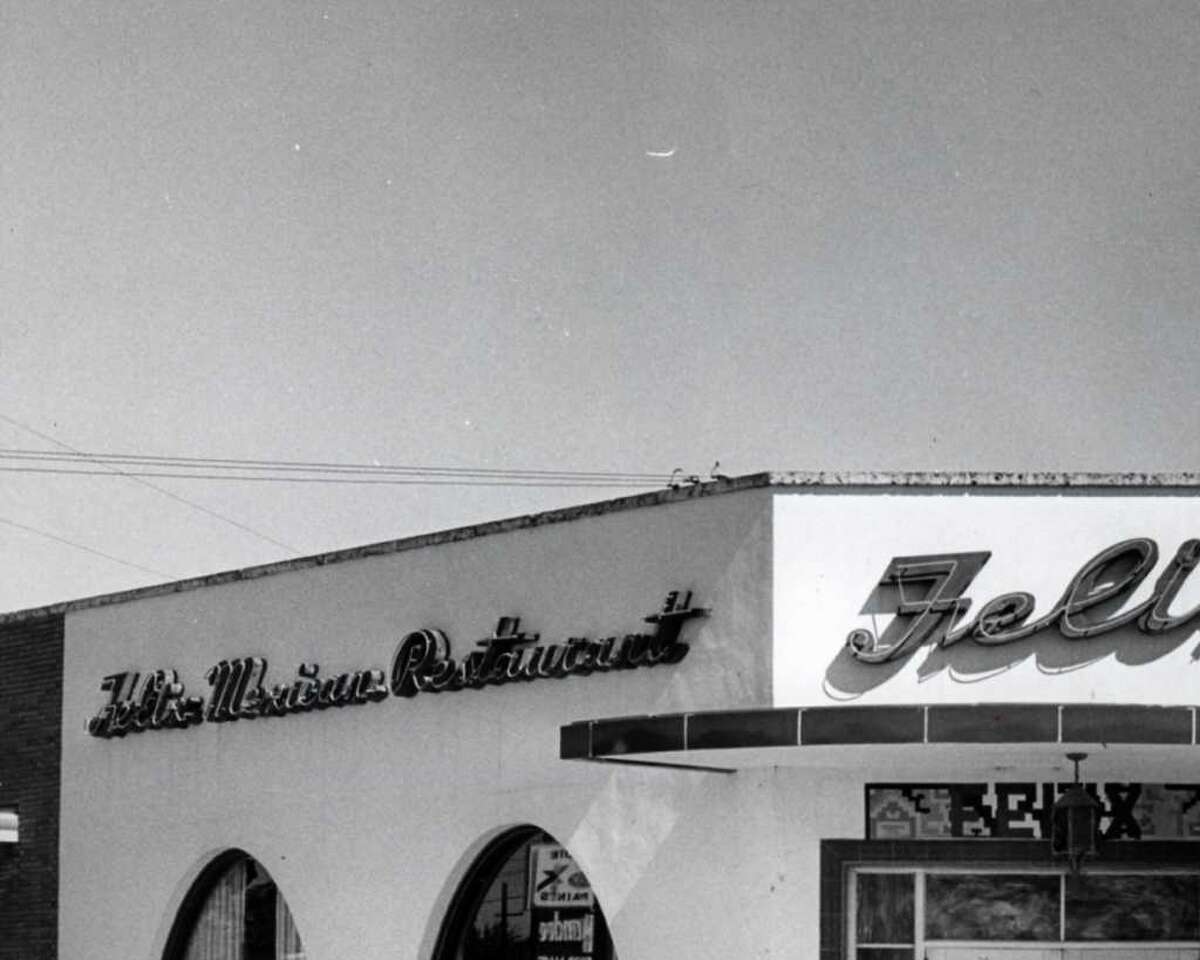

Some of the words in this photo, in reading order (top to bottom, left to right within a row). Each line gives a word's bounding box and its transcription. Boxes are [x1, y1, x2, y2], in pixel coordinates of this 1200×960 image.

[86, 669, 204, 738] Felix
[205, 656, 388, 722] Mexican
[391, 590, 711, 698] Restaurant
[951, 782, 1141, 839] FELX
